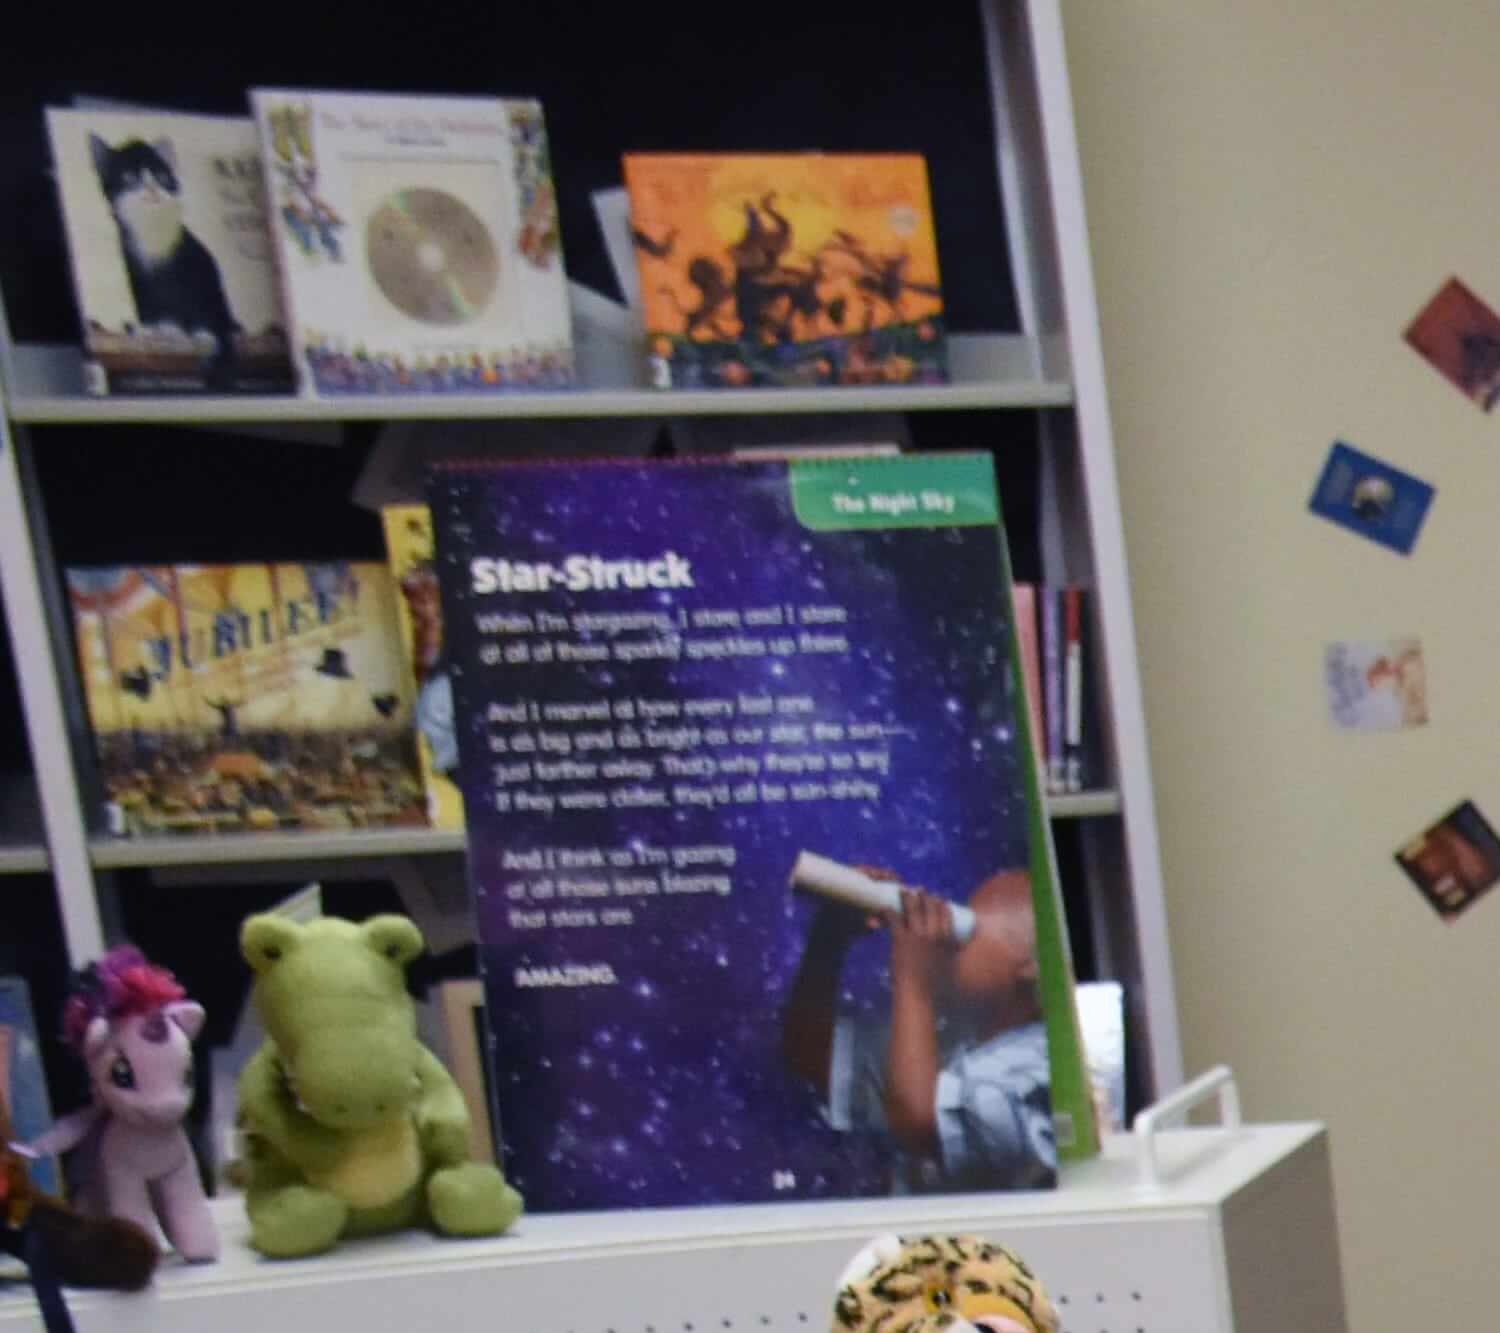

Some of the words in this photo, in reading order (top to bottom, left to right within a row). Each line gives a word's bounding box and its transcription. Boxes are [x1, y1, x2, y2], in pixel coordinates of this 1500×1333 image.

[833, 492, 864, 512] The
[869, 490, 918, 515] Night
[920, 488, 956, 514] Sky
[470, 551, 695, 594] Star-Struck
[744, 604, 783, 625] and
[488, 702, 527, 722] And
[613, 700, 635, 719] at
[537, 730, 572, 756] big
[574, 729, 615, 751] and
[645, 723, 702, 752] bright
[732, 727, 764, 745] our
[812, 722, 846, 741] the
[514, 790, 556, 815] they
[558, 792, 609, 810] were
[760, 781, 788, 802] be
[502, 850, 543, 870] And
